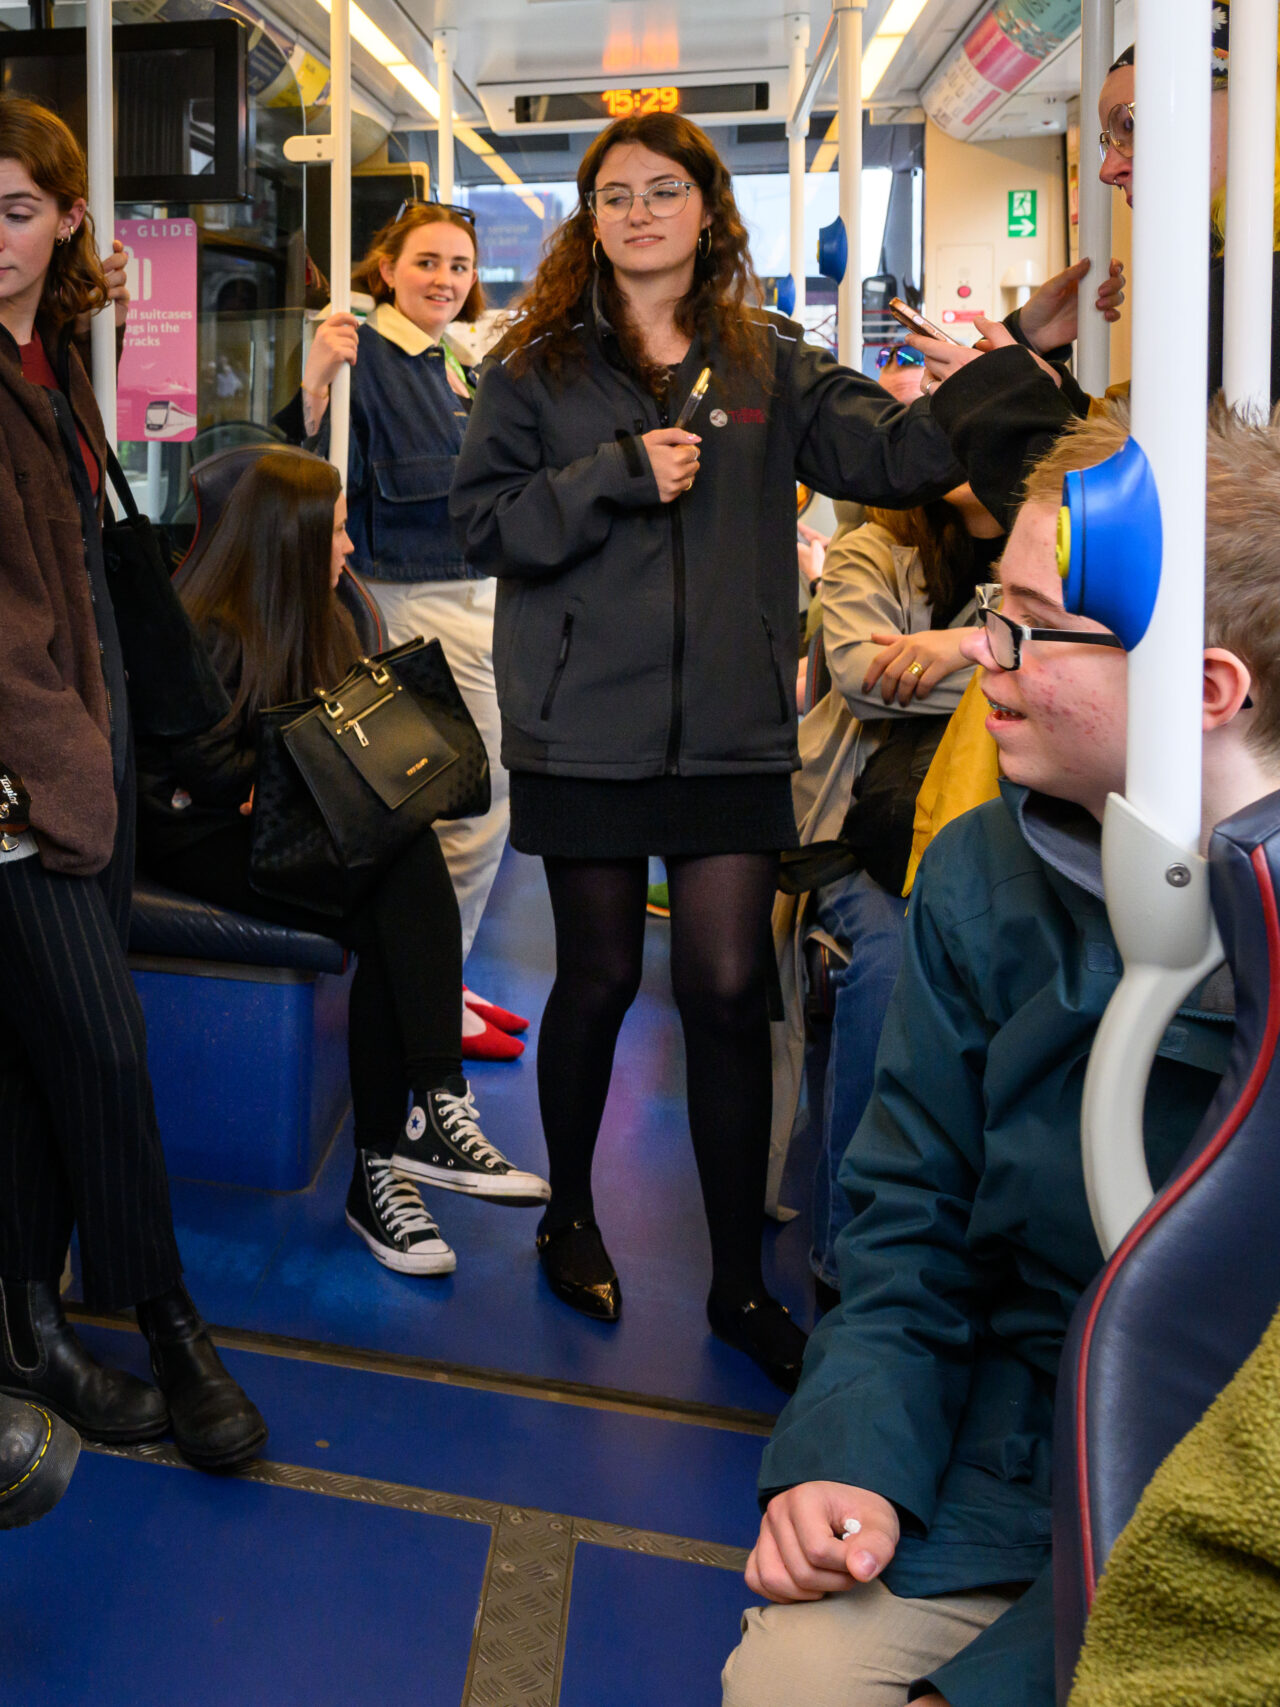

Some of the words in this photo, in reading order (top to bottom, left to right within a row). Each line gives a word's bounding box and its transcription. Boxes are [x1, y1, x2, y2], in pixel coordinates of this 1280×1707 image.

[602, 86, 679, 118] 15:29
[137, 223, 194, 238] GLIDE
[140, 308, 193, 320] suitcases
[126, 324, 145, 335] ags
[147, 321, 159, 333] in
[161, 321, 181, 333] the
[129, 335, 161, 347] racks
